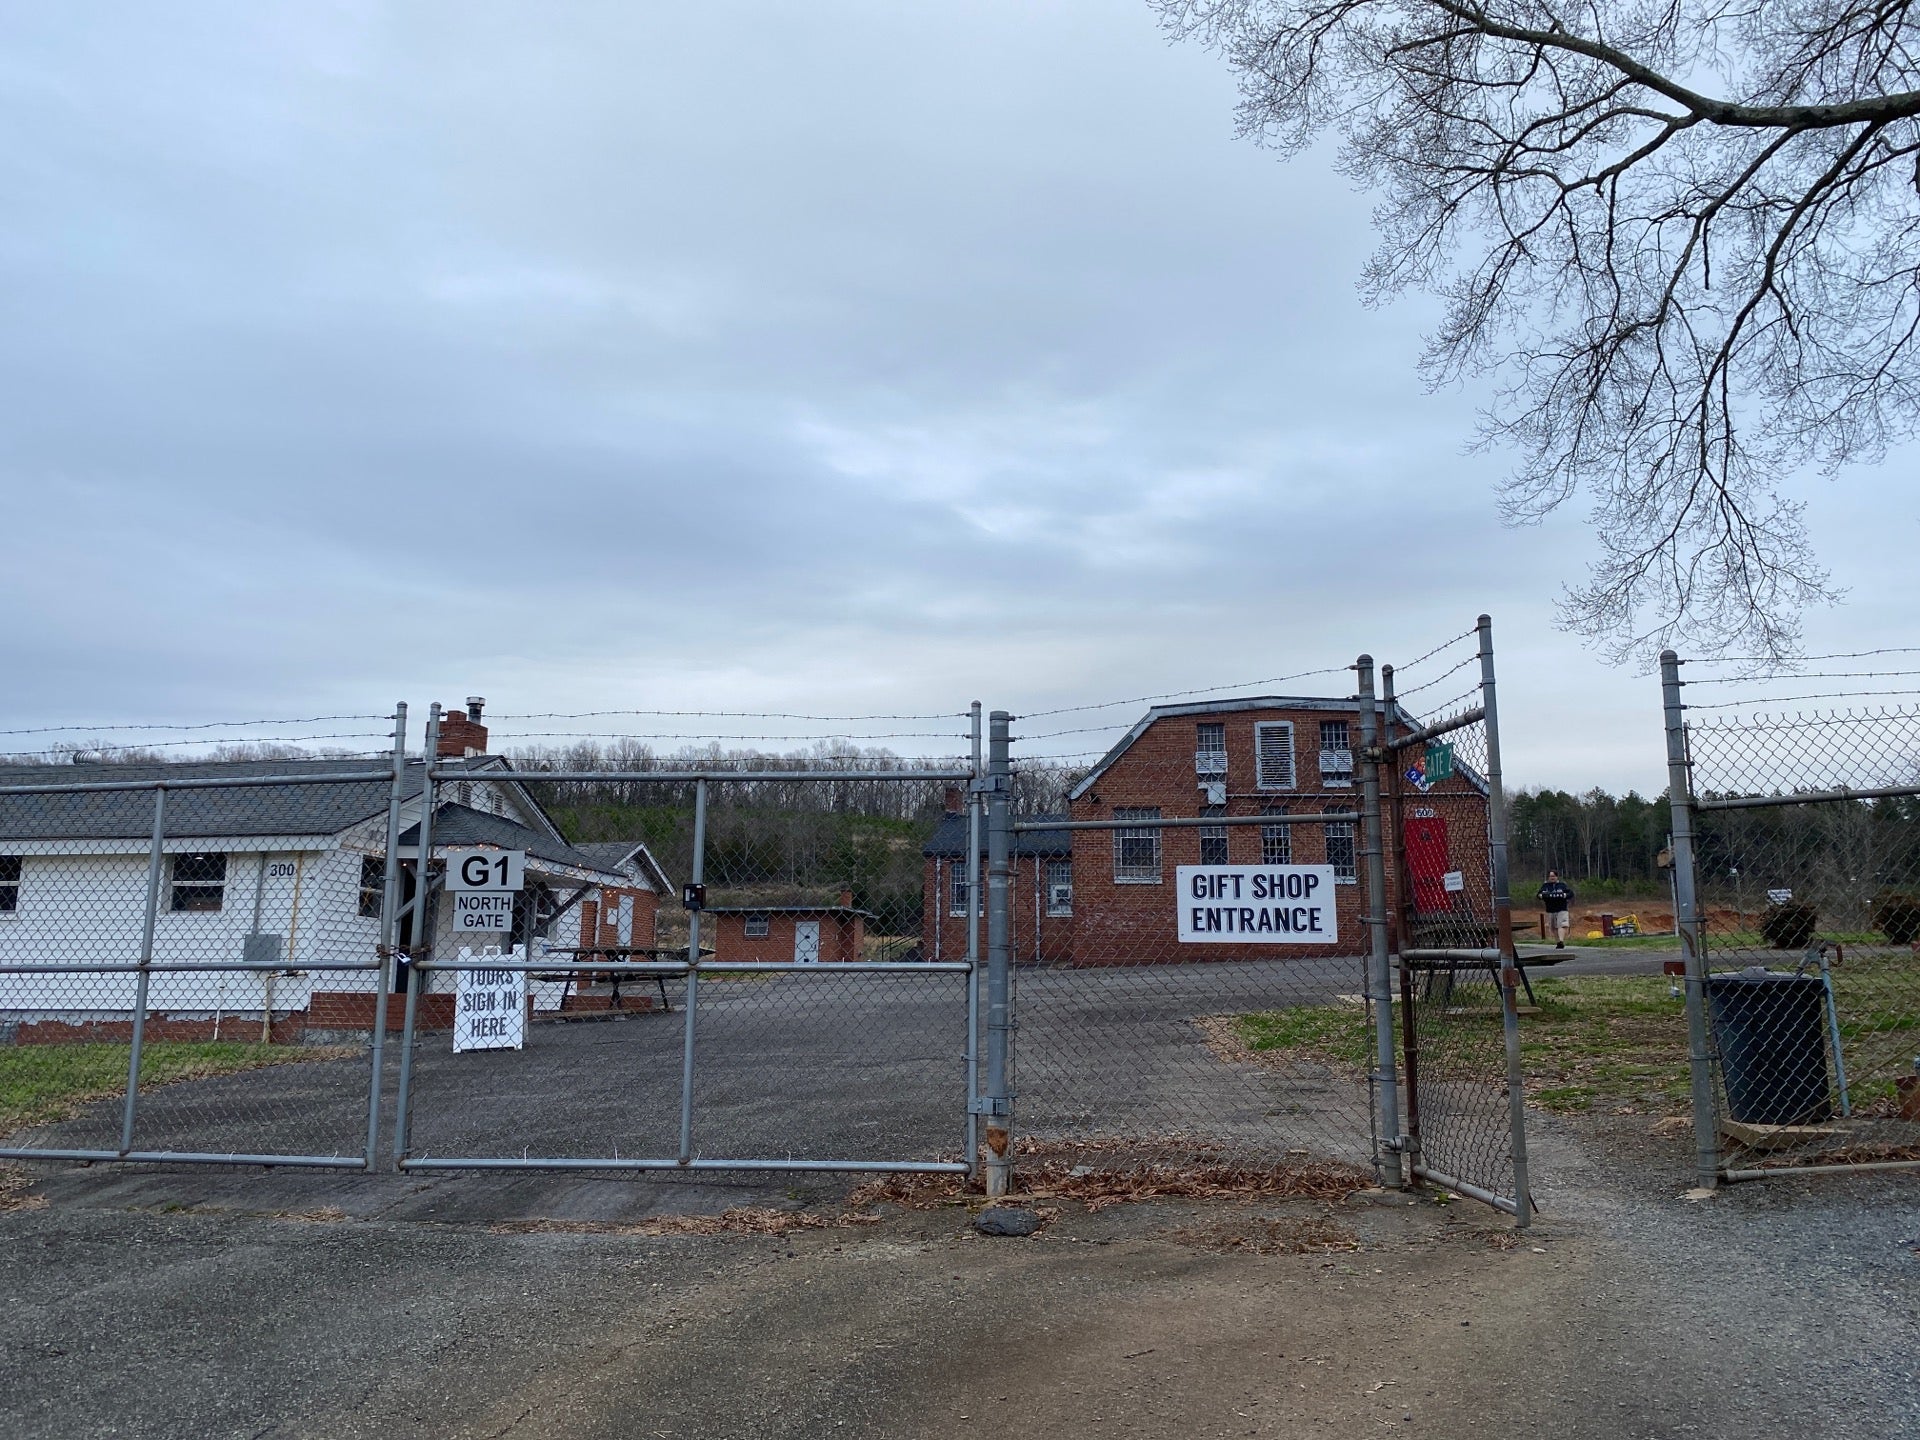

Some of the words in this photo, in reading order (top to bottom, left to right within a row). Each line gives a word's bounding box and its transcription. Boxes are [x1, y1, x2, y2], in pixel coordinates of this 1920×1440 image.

[1425, 751, 1444, 778] GATE
[1448, 748, 1453, 772] 2
[270, 864, 295, 876] 300
[461, 855, 509, 887] G1
[1191, 873, 1245, 900] GIFT
[1251, 873, 1319, 900] SHOP
[458, 896, 511, 911] NORTH
[463, 914, 504, 928] GATE
[1191, 907, 1323, 933] ENTRANCE
[463, 992, 496, 1012] SIGN
[503, 991, 517, 1010] IN
[471, 1017, 508, 1038] HERE
